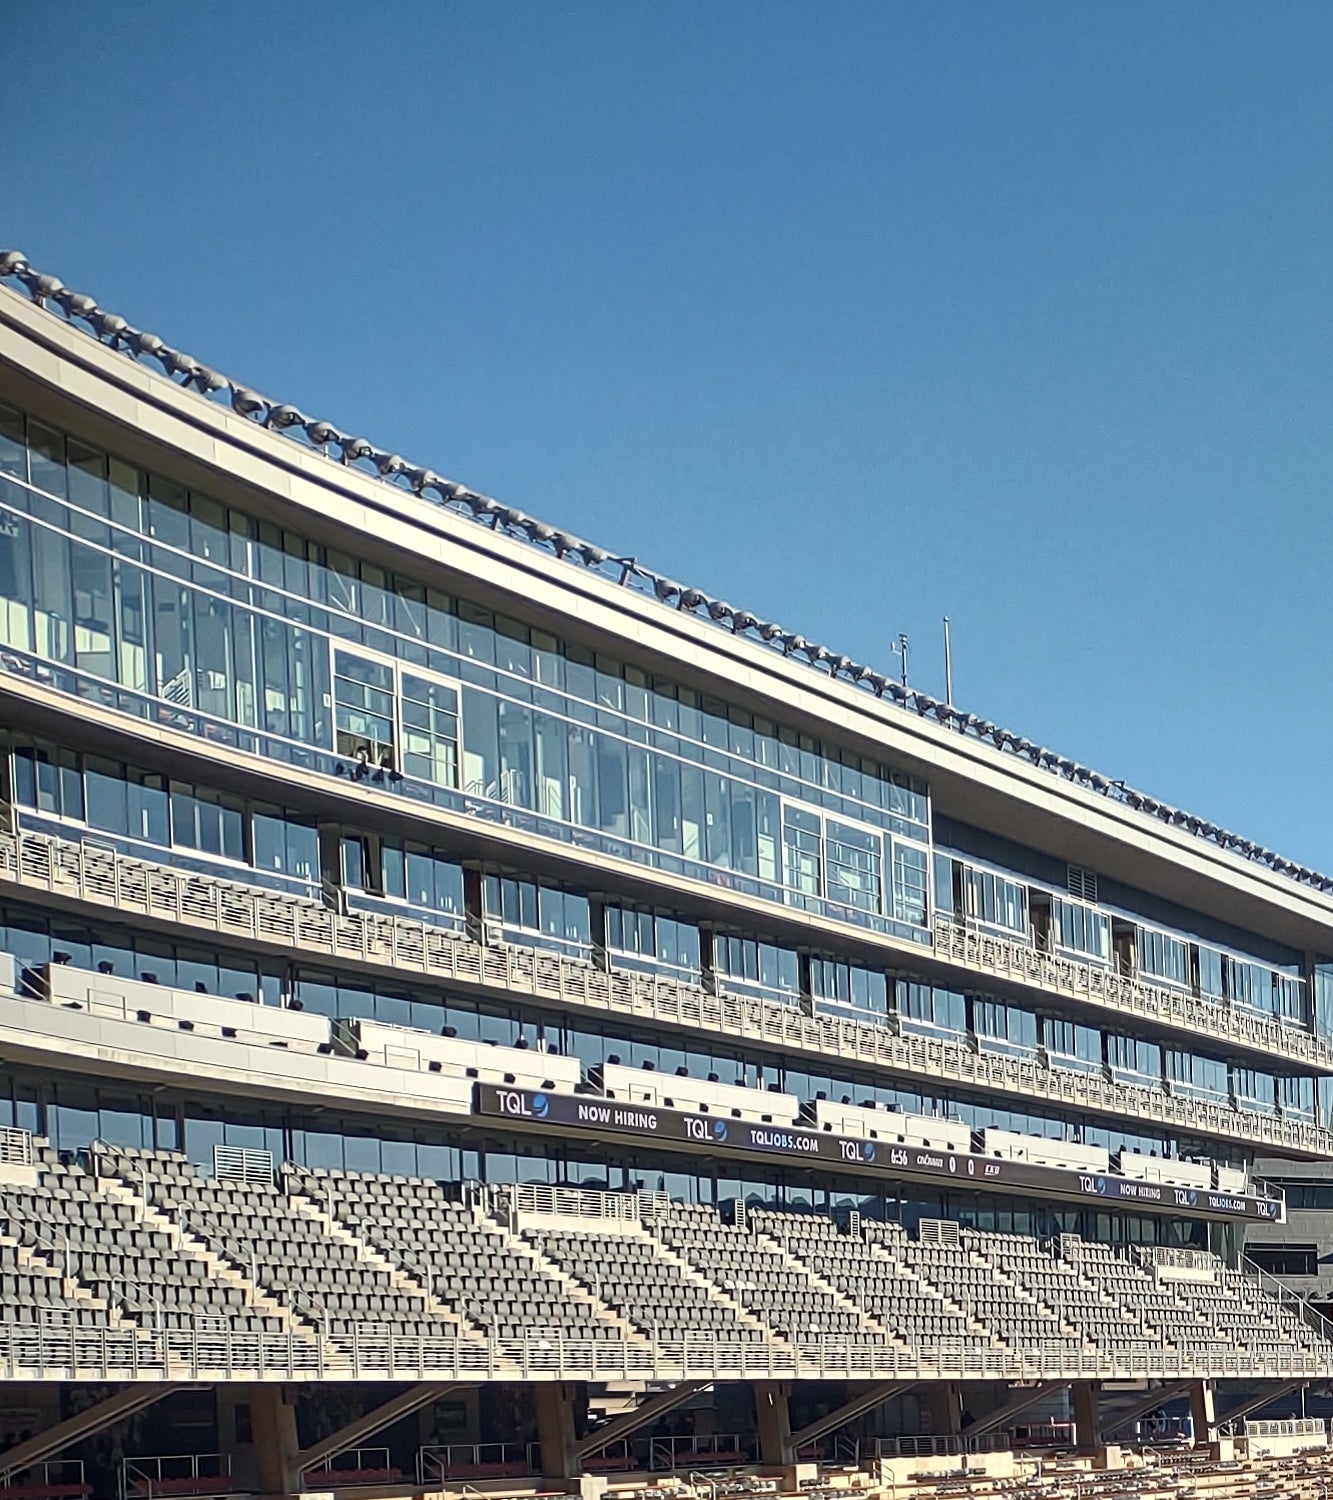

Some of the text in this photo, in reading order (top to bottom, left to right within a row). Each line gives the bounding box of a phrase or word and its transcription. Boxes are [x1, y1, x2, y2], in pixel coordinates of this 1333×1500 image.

[496, 1090, 532, 1117] TQL
[578, 1104, 658, 1130] NOW HIRING
[683, 1117, 714, 1141] TQL
[750, 1129, 819, 1152] TQLJOBS.COM
[838, 1140, 865, 1162] TQL
[890, 1148, 908, 1166] 6:56
[949, 1156, 956, 1173] 0
[968, 1159, 975, 1175] 0
[1079, 1175, 1098, 1194] TQL
[1120, 1183, 1161, 1199] NOW HIRING
[1174, 1189, 1190, 1206] TQL
[1256, 1201, 1271, 1217] TQL
